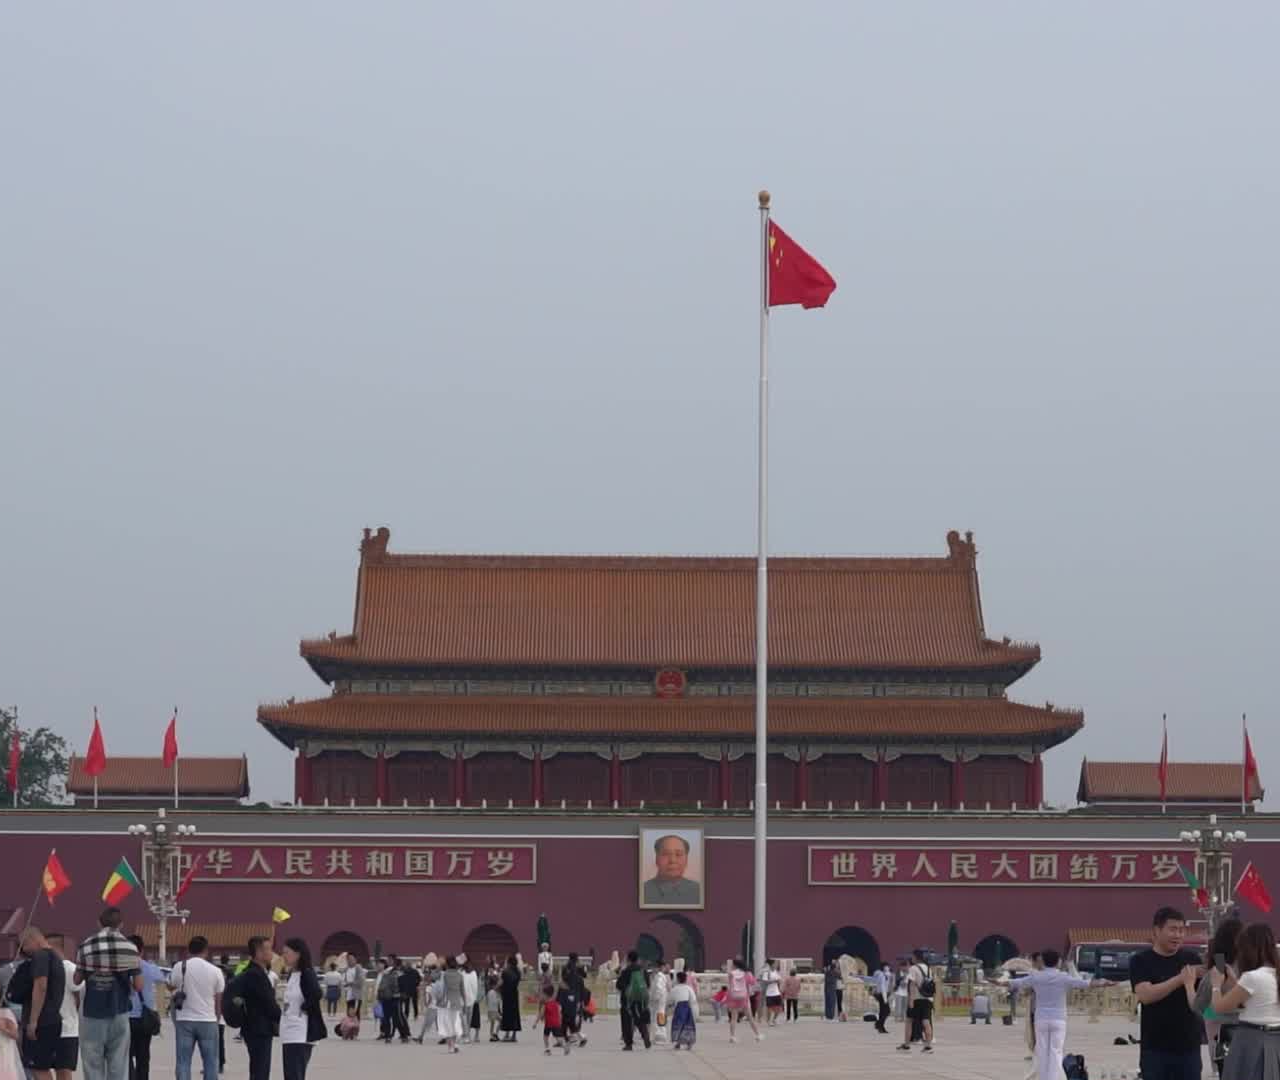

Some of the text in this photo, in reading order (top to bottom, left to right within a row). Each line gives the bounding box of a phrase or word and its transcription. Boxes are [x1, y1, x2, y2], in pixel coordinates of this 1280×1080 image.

[830, 852, 1179, 880] 世界人民大团结万岁
